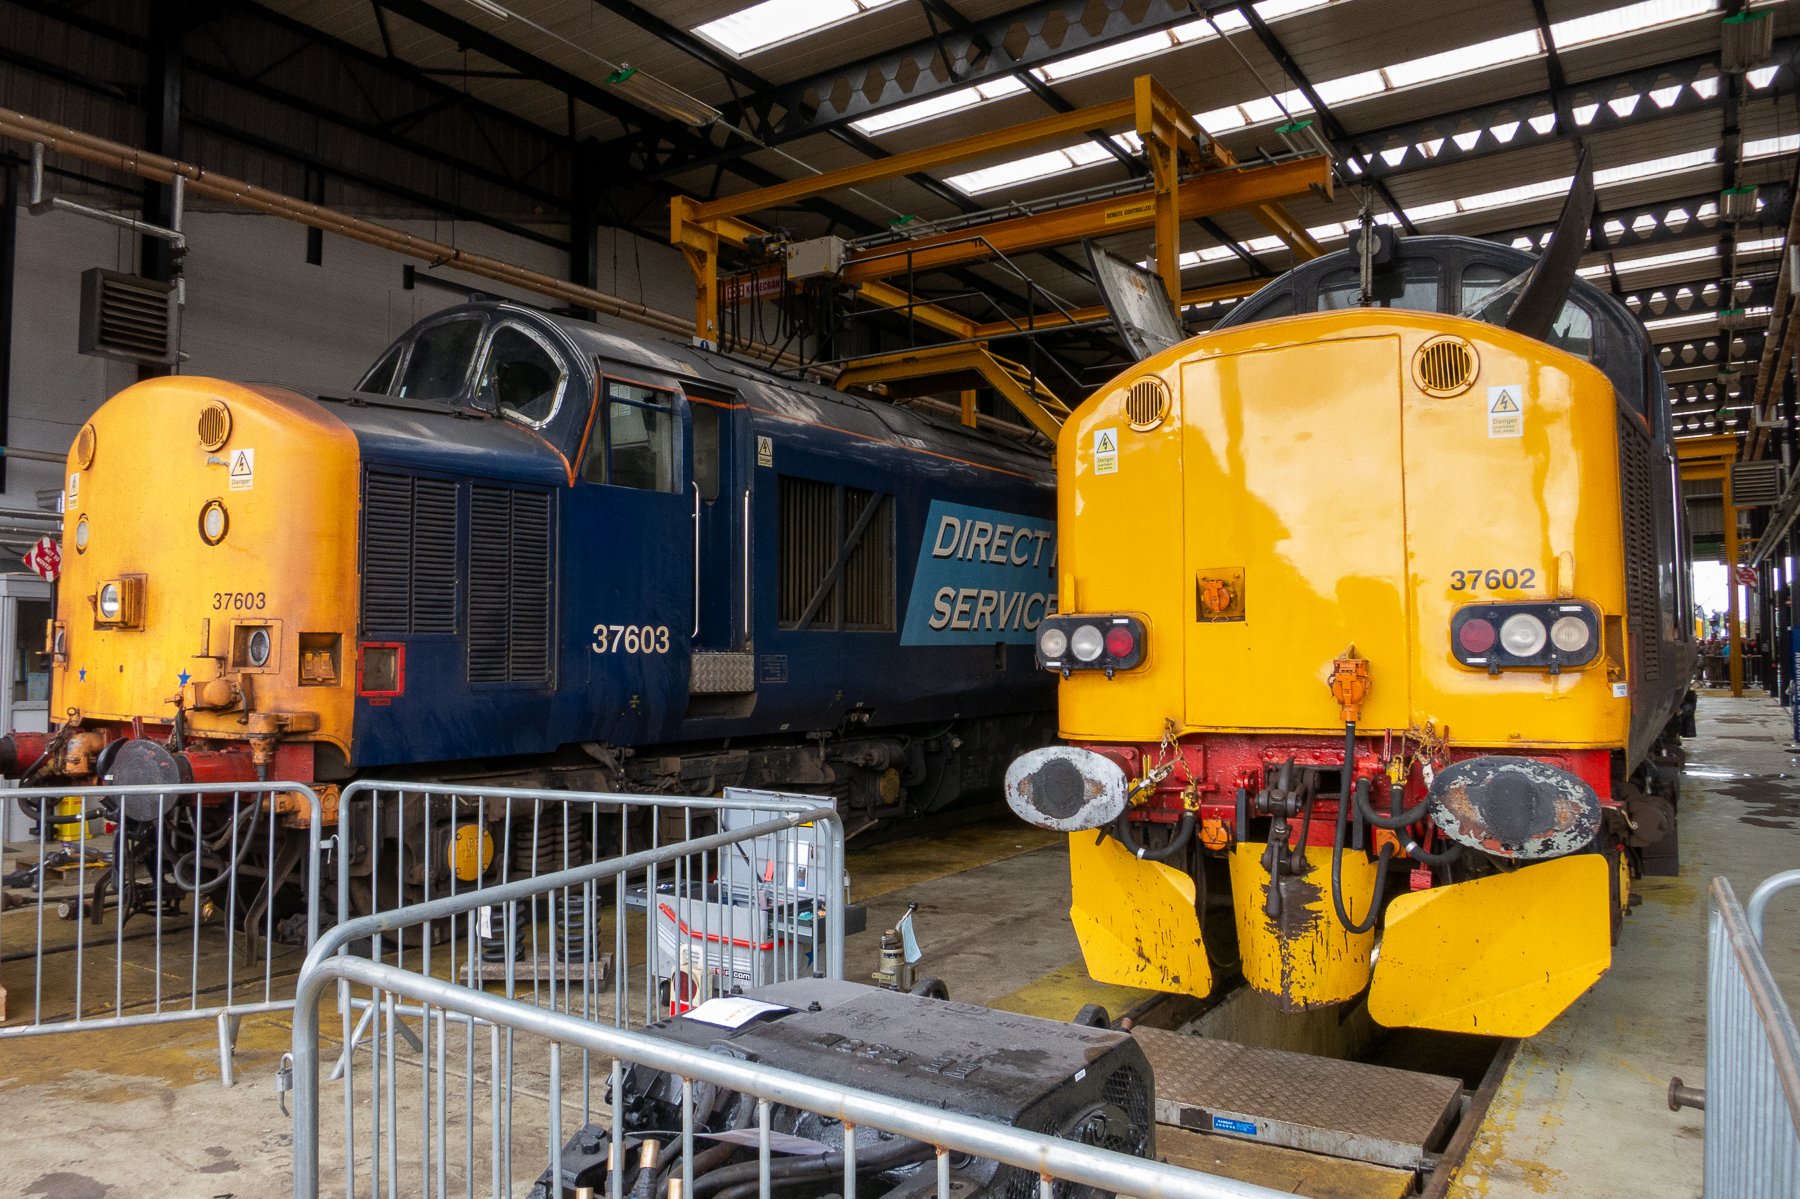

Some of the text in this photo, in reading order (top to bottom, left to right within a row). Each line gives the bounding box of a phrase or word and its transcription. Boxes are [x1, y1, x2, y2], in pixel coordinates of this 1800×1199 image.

[1124, 204, 1152, 216] CONTROLLED
[231, 478, 251, 486] Danger
[931, 515, 1052, 569] DIRECT
[44, 548, 54, 556] NOT
[36, 556, 52, 570] MOVED
[1450, 567, 1536, 591] 37602
[212, 591, 266, 610] 37603
[592, 624, 670, 654] 37603
